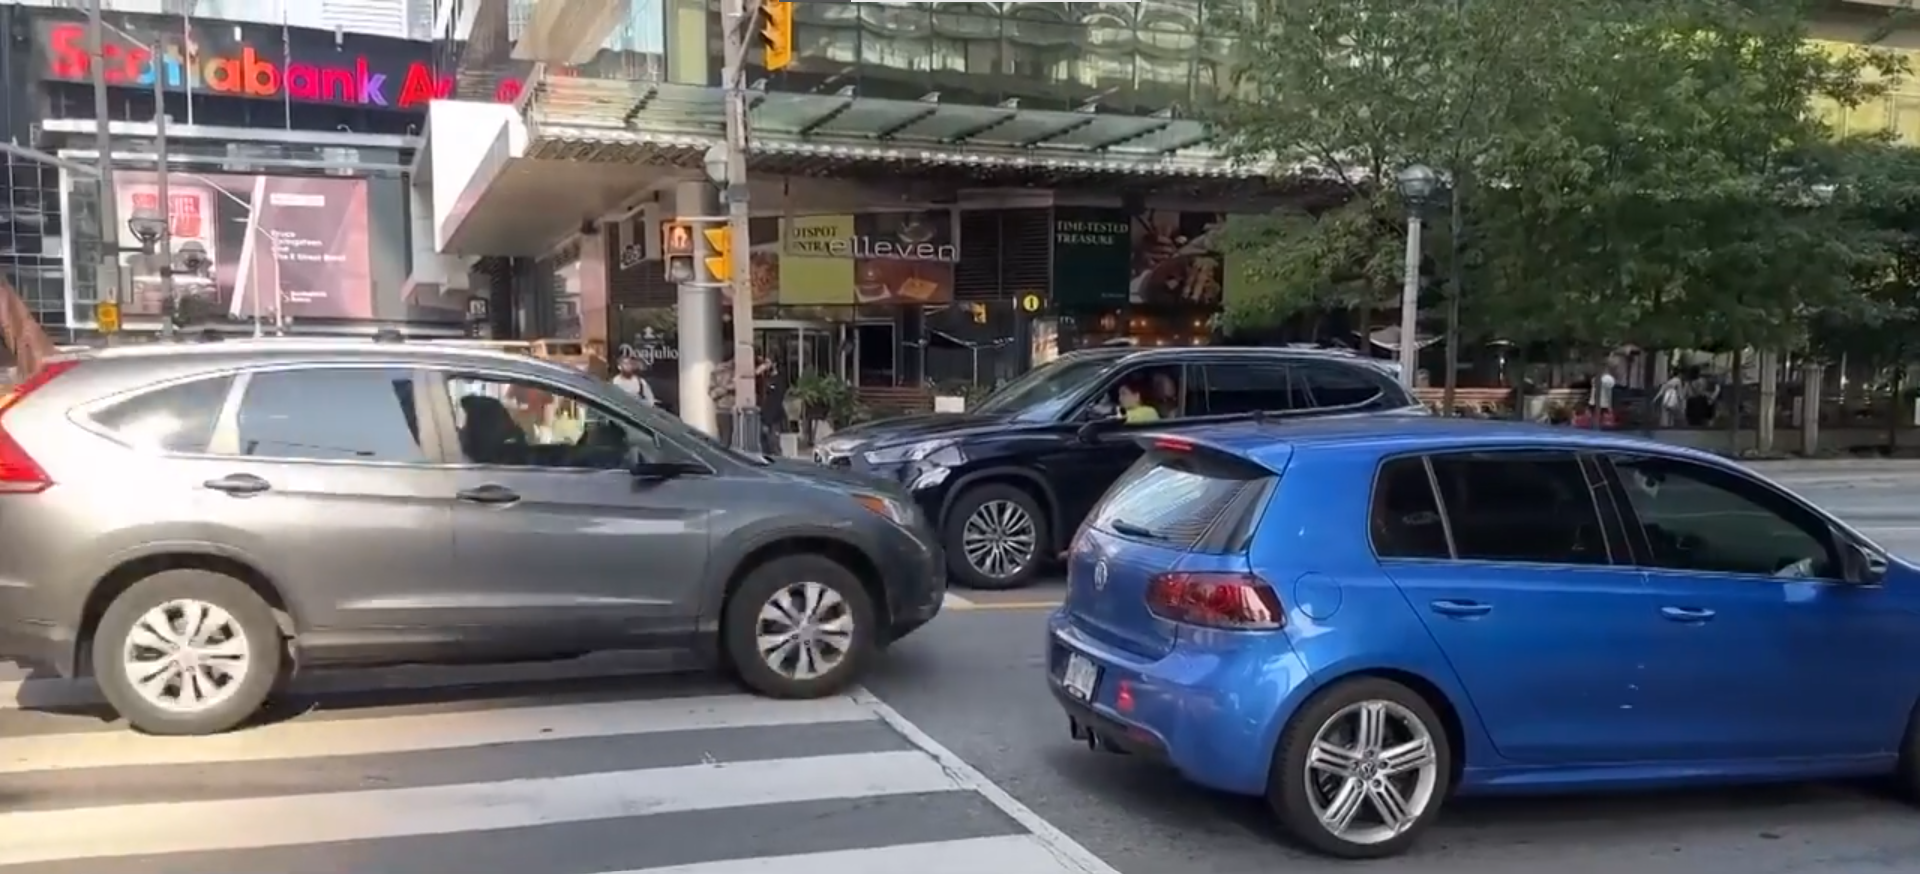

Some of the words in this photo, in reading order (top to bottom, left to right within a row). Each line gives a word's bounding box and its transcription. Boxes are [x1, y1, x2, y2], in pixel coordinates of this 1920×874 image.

[793, 226, 838, 239] OTSPOT
[1056, 220, 1129, 234] TIME-TESTED
[1056, 233, 1116, 245] TREASURE
[828, 235, 960, 262] elleven
